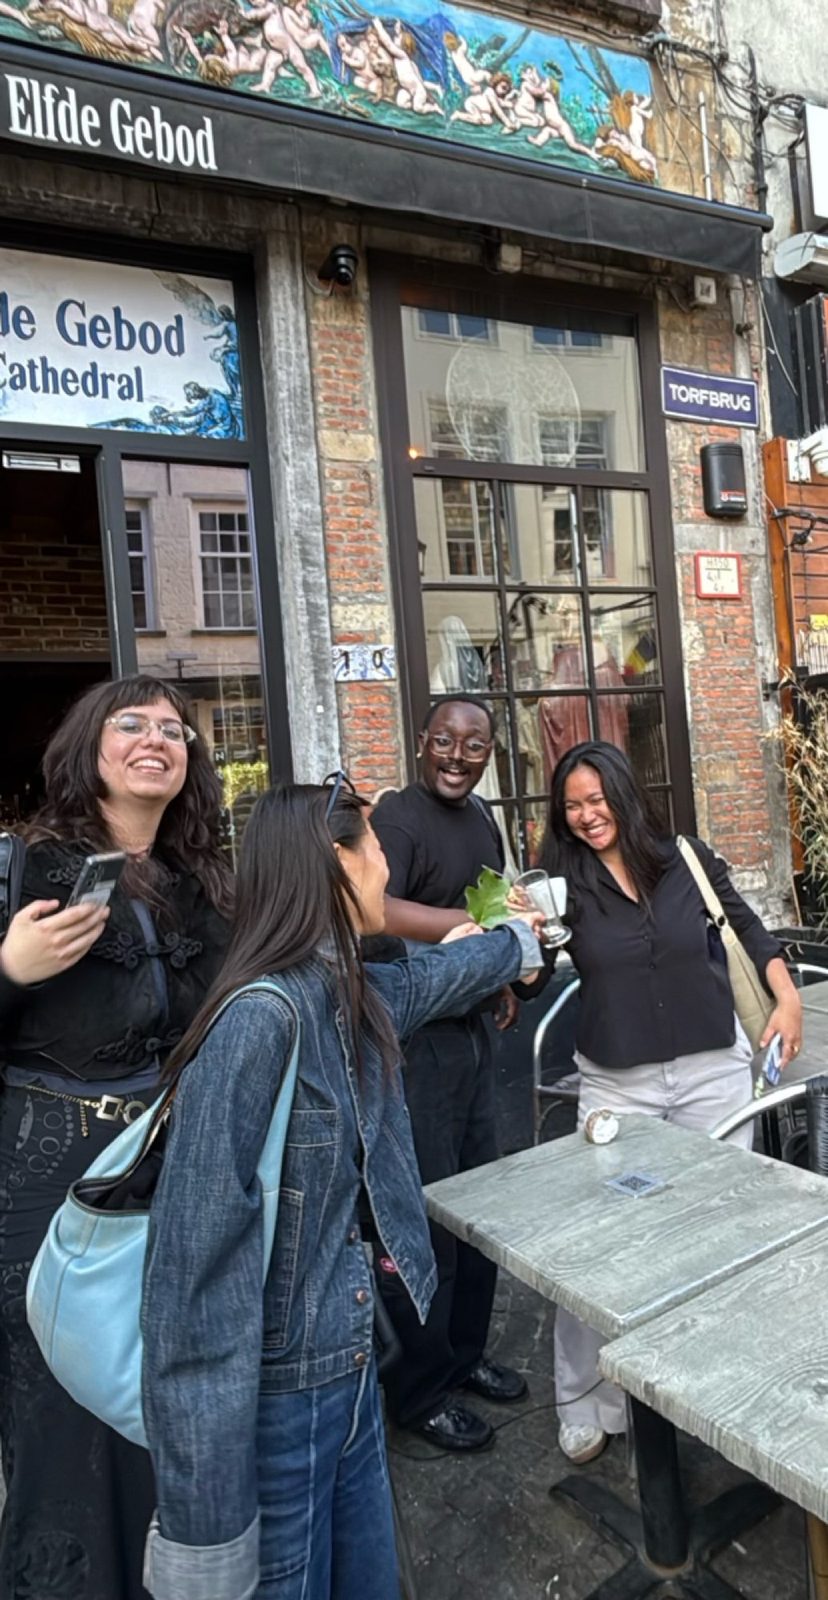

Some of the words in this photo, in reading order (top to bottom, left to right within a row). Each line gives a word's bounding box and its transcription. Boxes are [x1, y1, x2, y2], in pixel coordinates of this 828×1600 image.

[4, 74, 102, 147] Elfde
[110, 97, 218, 170] Gebod
[56, 299, 185, 357] Gebod
[669, 383, 752, 412] TORFBRUG
